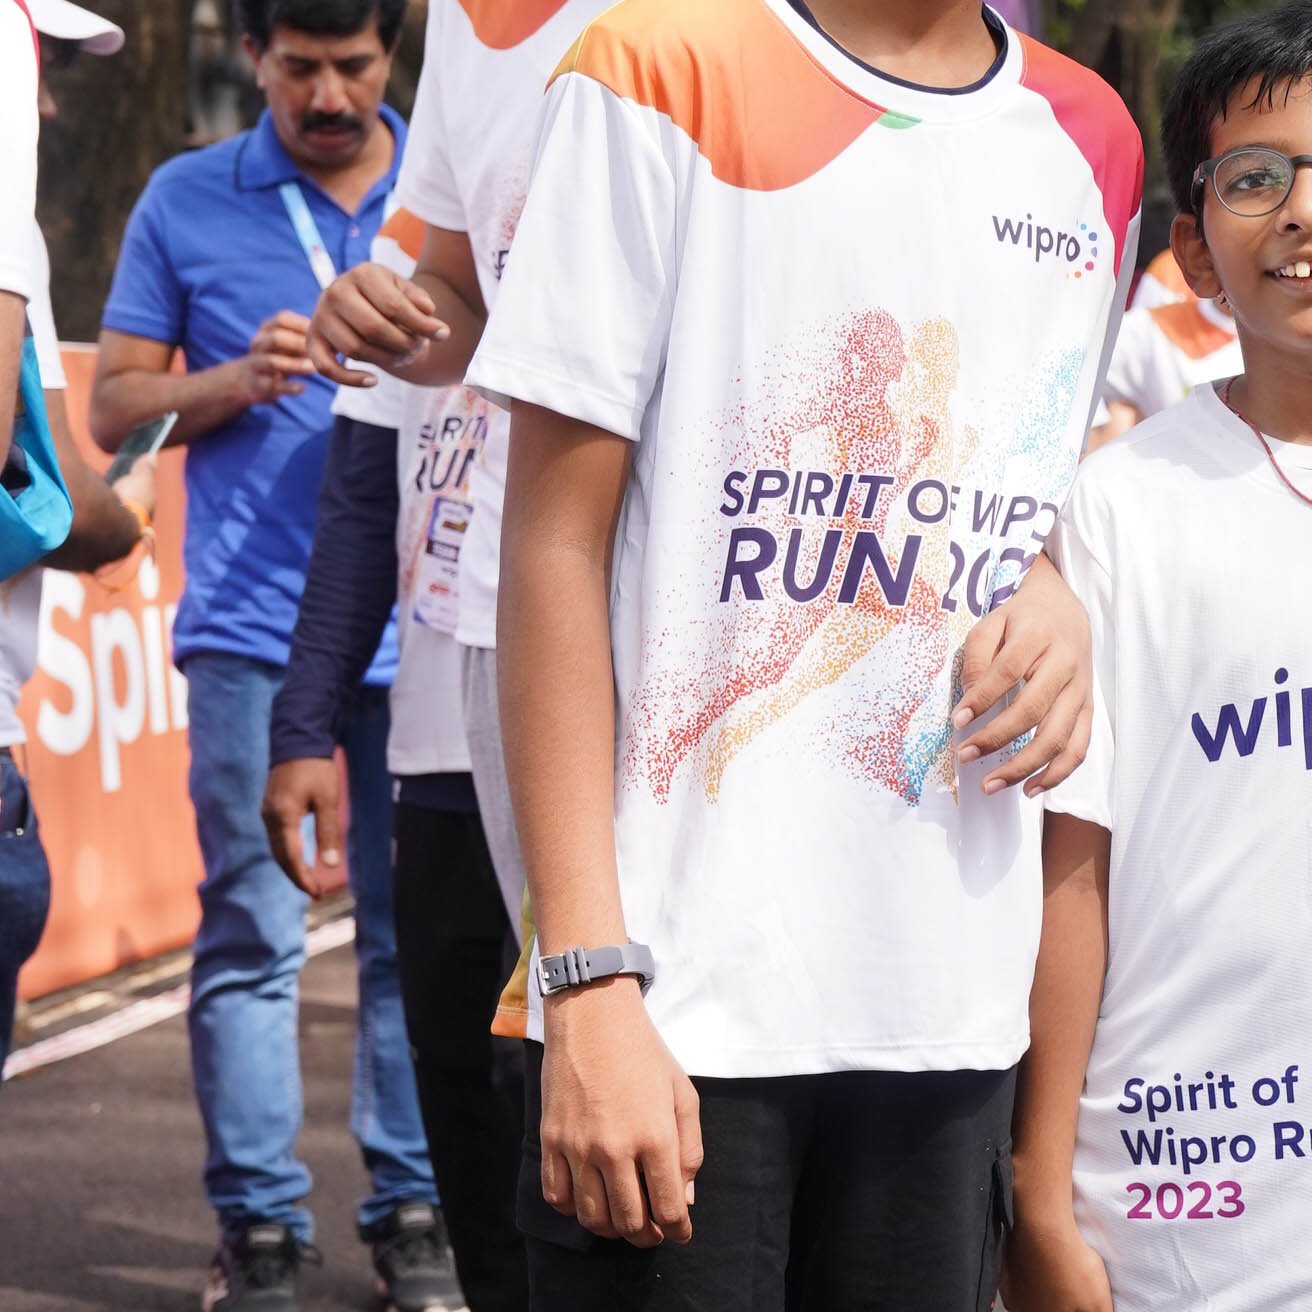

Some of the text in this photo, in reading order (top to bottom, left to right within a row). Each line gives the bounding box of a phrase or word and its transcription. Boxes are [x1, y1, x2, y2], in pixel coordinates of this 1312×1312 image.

[993, 213, 1080, 262] wipro
[719, 470, 894, 521] SPIRIT
[719, 529, 922, 607] RUN
[1117, 1065, 1299, 1122] Spirit of
[1121, 1127, 1256, 1174] Wipro
[1126, 1180, 1246, 1220] 2023
